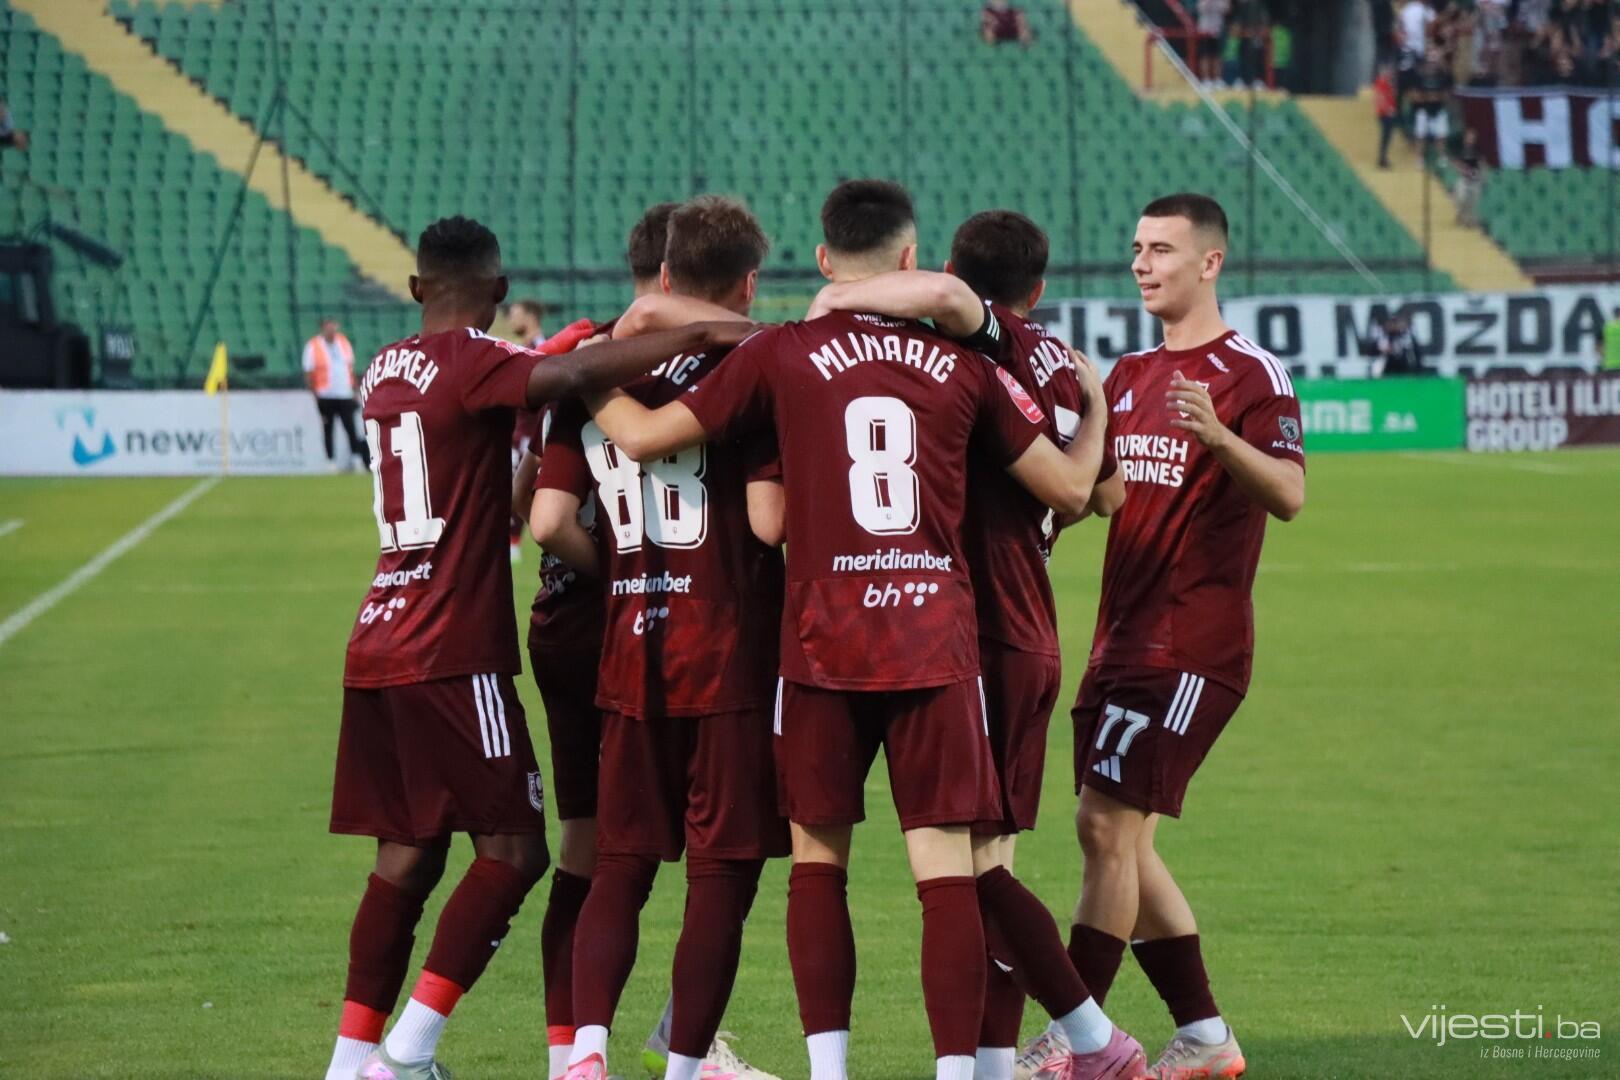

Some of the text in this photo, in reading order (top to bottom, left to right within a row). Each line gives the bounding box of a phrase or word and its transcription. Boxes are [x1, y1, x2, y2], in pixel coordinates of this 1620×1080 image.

[809, 332, 959, 384] MLINARIĆ
[1467, 380, 1568, 418] HOTELI
[1468, 418, 1568, 451] GROUP
[845, 396, 920, 536] 8
[833, 547, 952, 572] meridianbet
[863, 582, 902, 608] bh
[1095, 704, 1150, 757] 77
